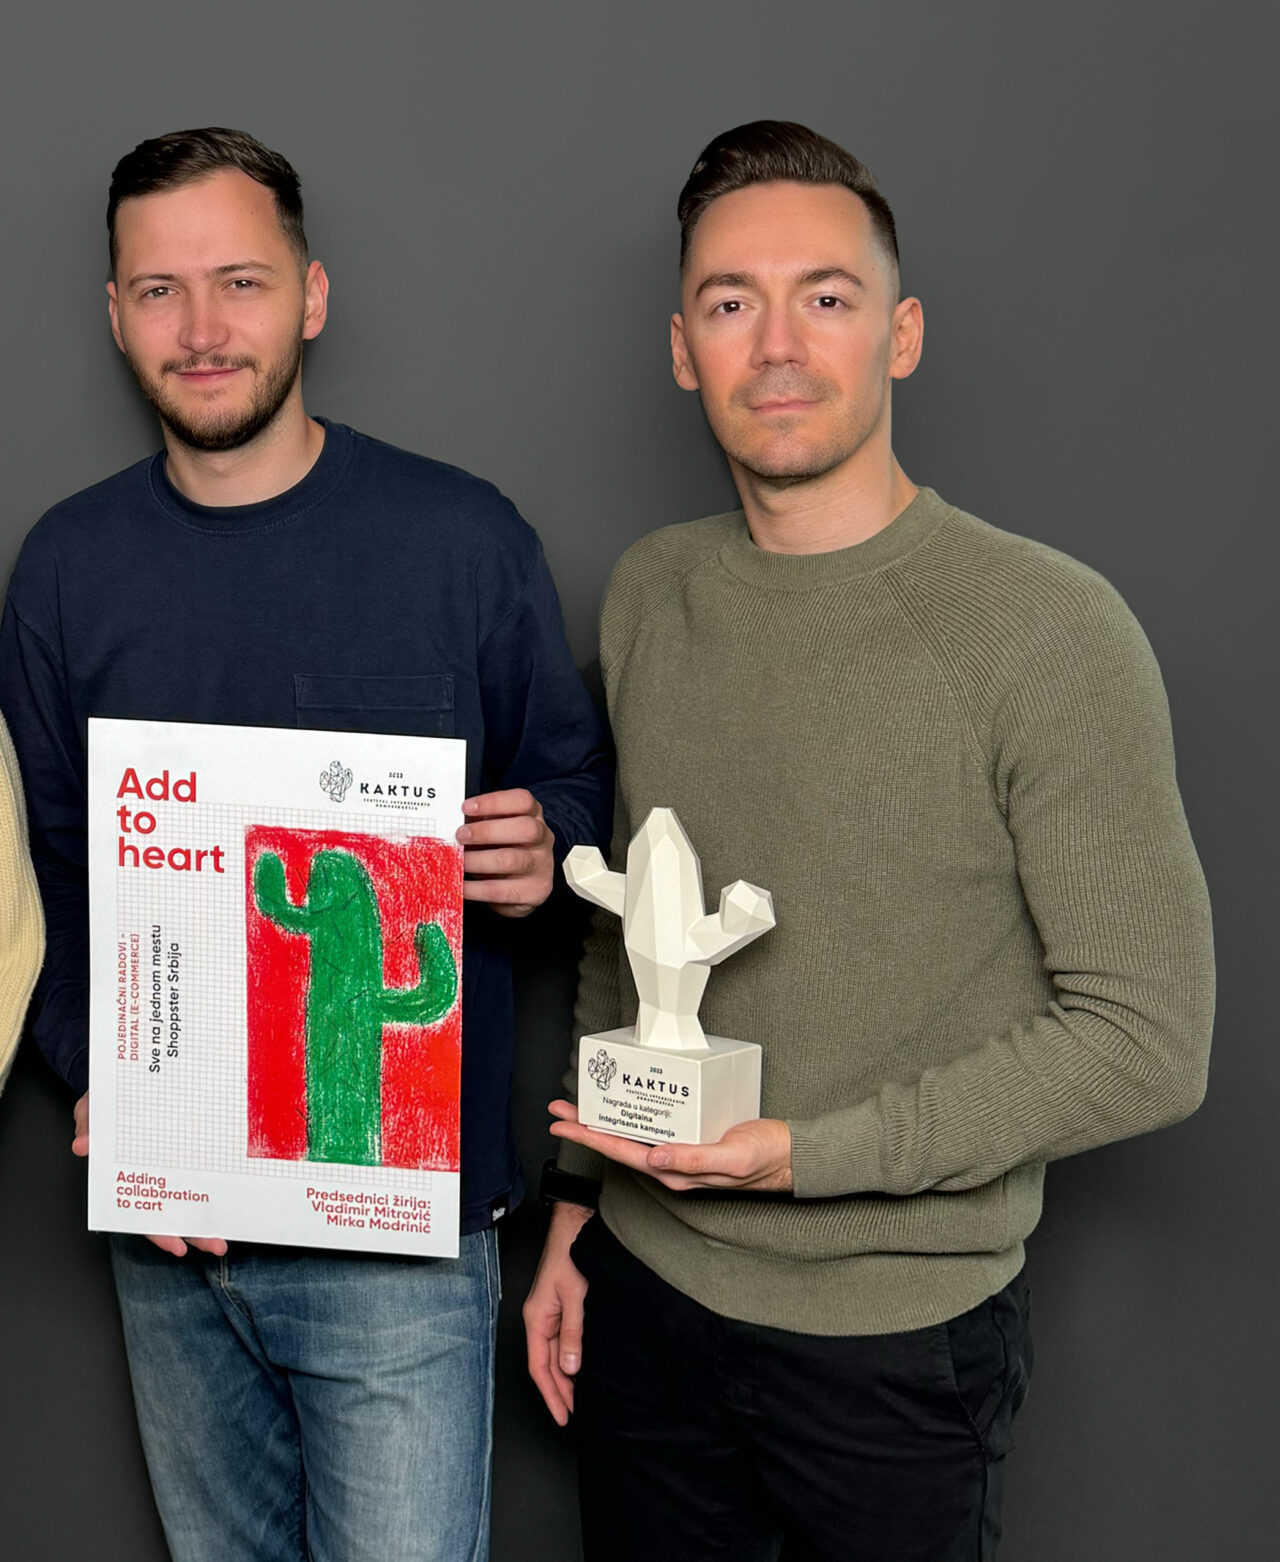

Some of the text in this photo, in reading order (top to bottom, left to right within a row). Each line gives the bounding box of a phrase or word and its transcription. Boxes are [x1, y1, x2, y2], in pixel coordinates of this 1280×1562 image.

[117, 767, 196, 803] Add
[360, 783, 436, 798] KAKTUS
[117, 805, 156, 834] to
[119, 836, 225, 873] heart
[118, 942, 127, 983] RADOVI
[130, 934, 140, 1060] DIGITAL (E-COMMERCE)
[150, 925, 164, 1073] Sve na jednom mestu
[167, 943, 182, 1057] Shoppster Srbija
[117, 988, 126, 1059] POJEDINAČNI
[622, 1073, 689, 1097] KAKTUS
[603, 1096, 631, 1108] Nagrada
[621, 1109, 652, 1123] Digitalna
[640, 1124, 675, 1137] kampanja
[116, 1171, 166, 1189] Adding
[116, 1184, 209, 1202] collaboration
[116, 1198, 163, 1211] to cart
[307, 1187, 431, 1210] Predsednici žirija:
[312, 1200, 431, 1221] Vladimir Mitrović
[327, 1214, 431, 1233] Mirka Modrinić
